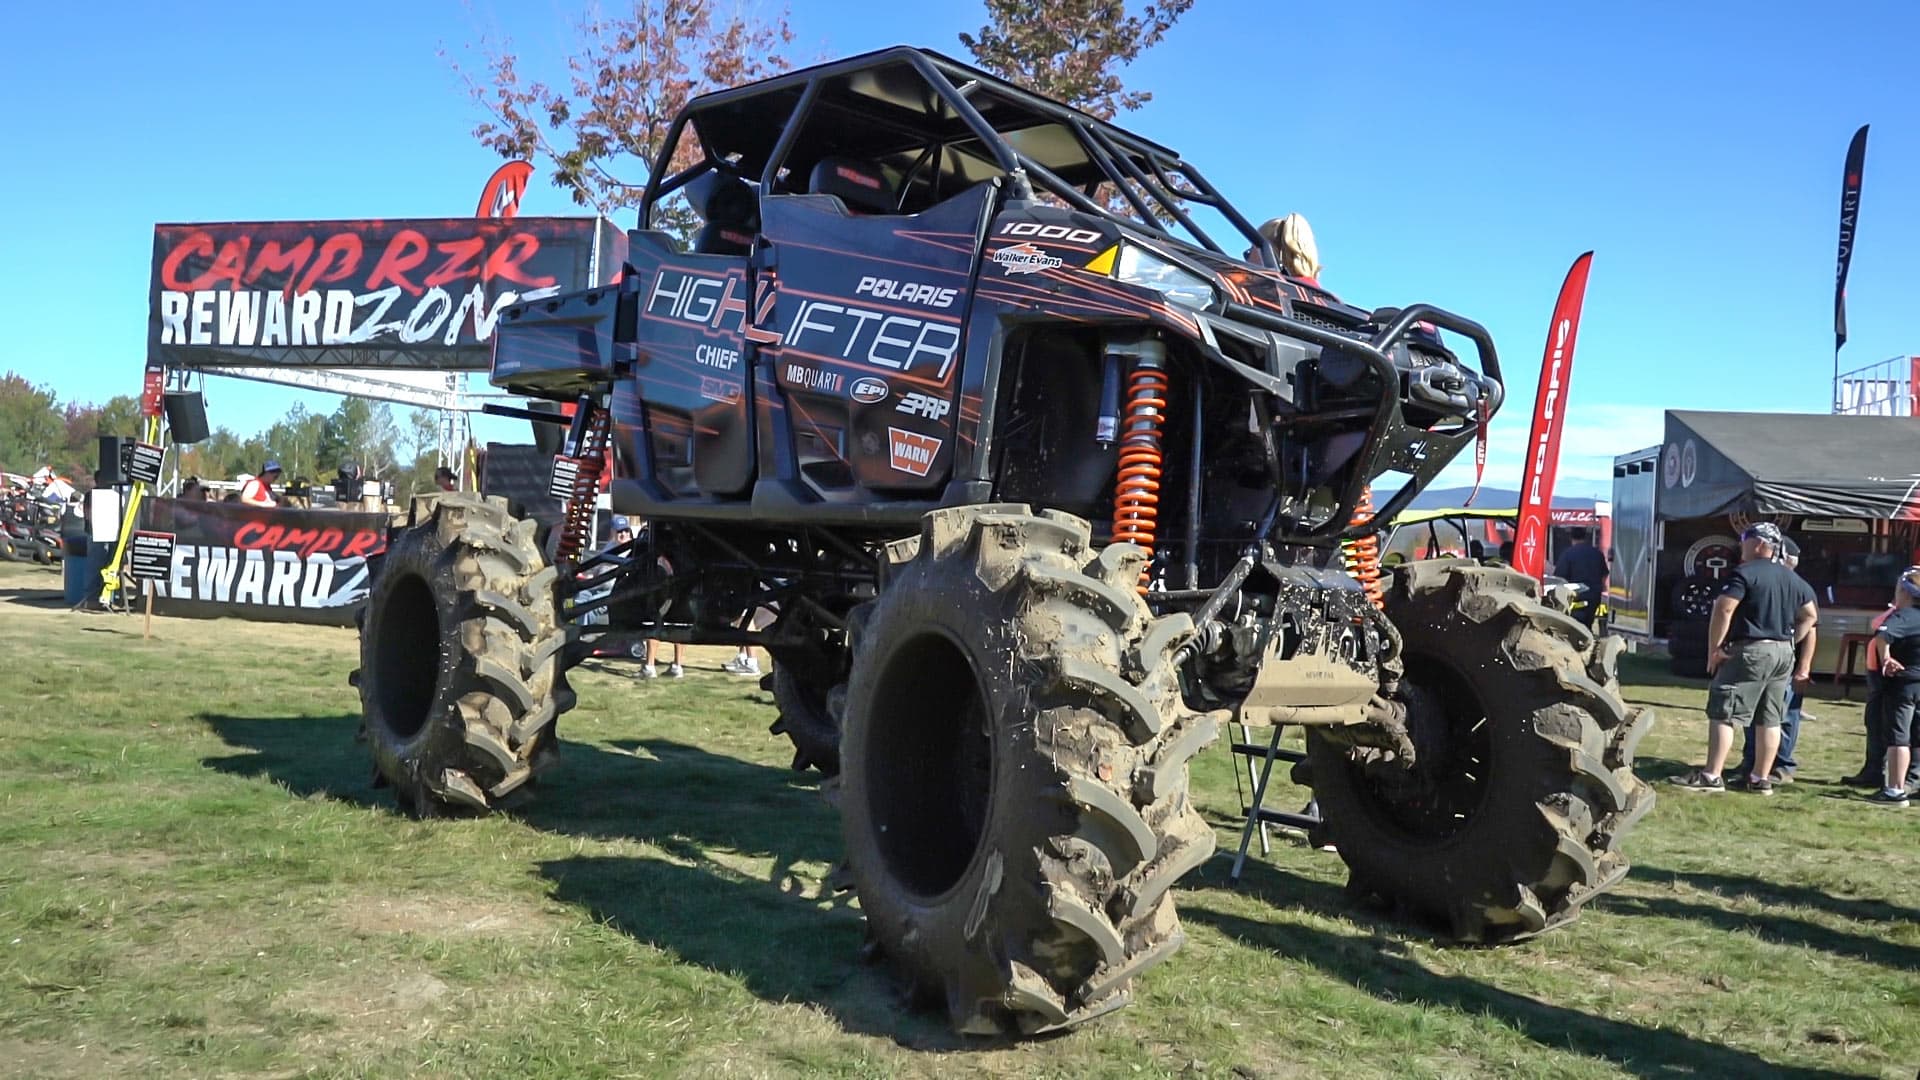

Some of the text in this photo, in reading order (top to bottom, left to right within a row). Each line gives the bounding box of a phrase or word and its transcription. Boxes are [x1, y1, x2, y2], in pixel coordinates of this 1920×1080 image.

[1001, 222, 1102, 243] 1000
[162, 229, 556, 303] CAMP RZR
[993, 251, 1062, 267] Walker Evans
[855, 276, 958, 308] POLARIS
[161, 282, 562, 346] REWARD ZON
[695, 344, 739, 370] CHIEF
[1529, 319, 1570, 505] POLARIS
[894, 441, 930, 464] WARN
[234, 521, 344, 559] CAMP
